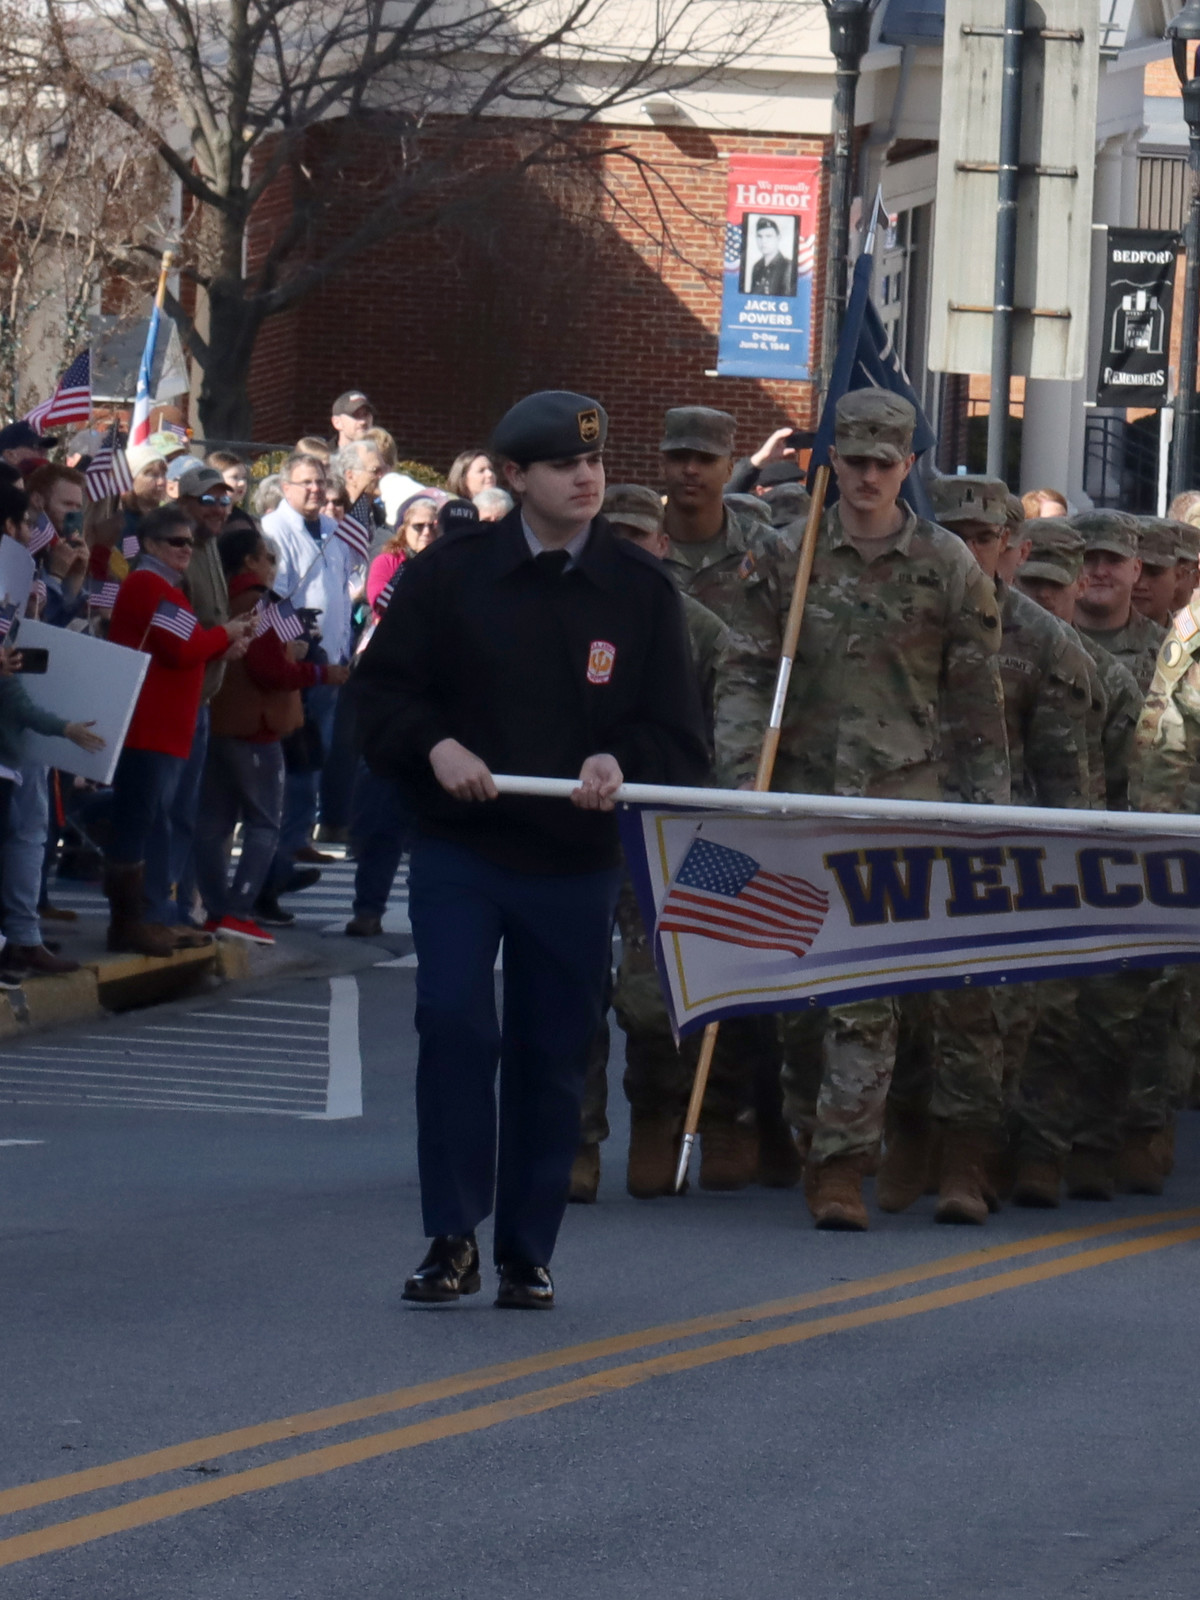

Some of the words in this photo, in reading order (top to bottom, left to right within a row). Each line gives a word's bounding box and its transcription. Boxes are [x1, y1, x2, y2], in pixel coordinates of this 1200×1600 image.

[757, 181, 772, 191] We
[773, 183, 811, 194] proudly
[736, 184, 811, 208] Honor
[1112, 250, 1174, 264] BEDFORD
[744, 300, 777, 312] JACK
[779, 302, 789, 313] G
[739, 312, 793, 326] POWERS
[752, 332, 778, 342] D-Day
[739, 341, 759, 349] June
[770, 343, 790, 351] 1944
[1104, 367, 1165, 386] REMEMBERS
[450, 507, 474, 519] NAVY
